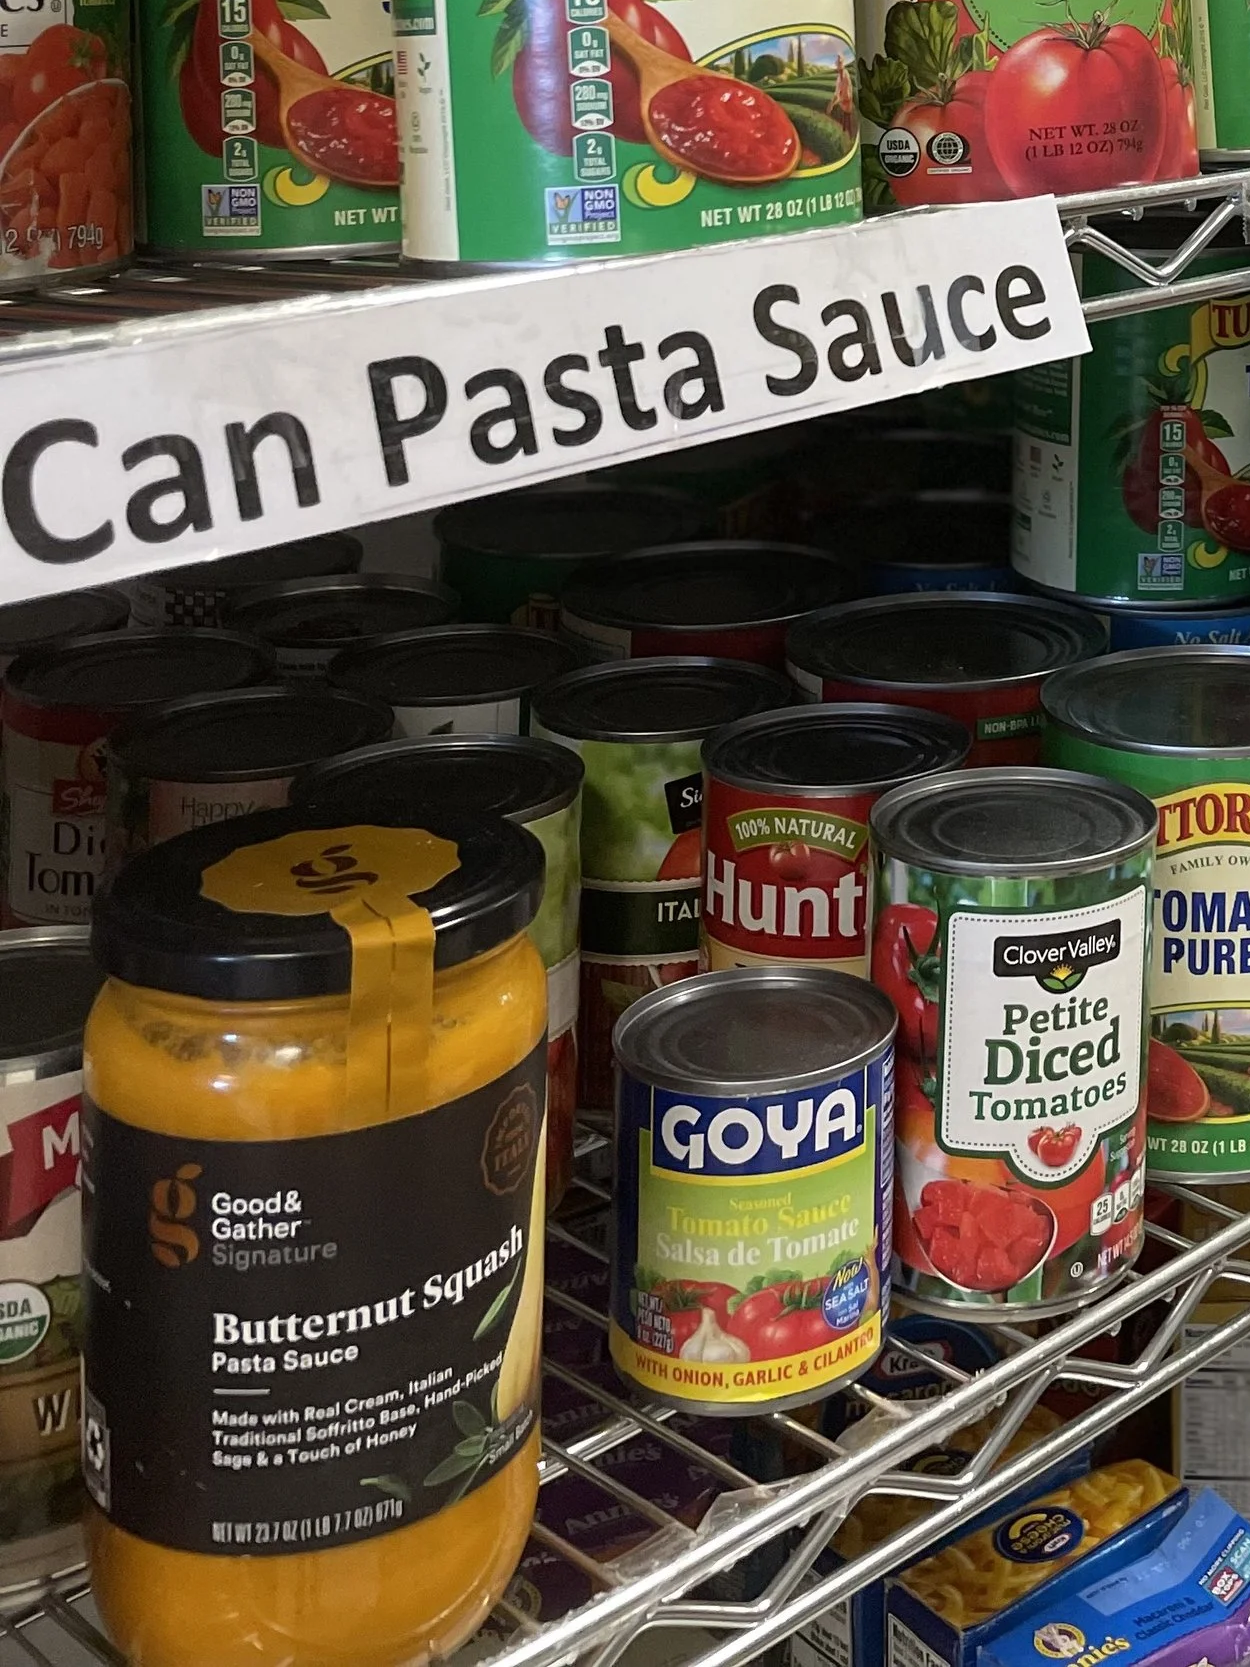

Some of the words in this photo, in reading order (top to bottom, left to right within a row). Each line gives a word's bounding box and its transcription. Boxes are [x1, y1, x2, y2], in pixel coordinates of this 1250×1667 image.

[887, 138, 911, 152] USDA
[584, 189, 615, 201] NON
[701, 207, 732, 227] NET
[738, 204, 762, 224] WT
[766, 202, 783, 221] 28
[787, 198, 803, 218] OZ
[806, 196, 816, 218] (1
[820, 193, 832, 212] LB
[206, 216, 258, 226] VERIFIED
[334, 209, 366, 226] NET
[372, 207, 398, 223] WT
[549, 221, 617, 235] VERIFIED
[2, 411, 321, 565] Can
[367, 325, 726, 487] Pasta
[753, 264, 1052, 397] Sauce
[735, 817, 770, 841] 100%
[774, 816, 857, 850] NATURAL
[1170, 854, 1224, 876] FAMILY
[1003, 944, 1066, 965] Clover
[1068, 934, 1113, 959] Valley
[1003, 996, 1109, 1036] Petite
[984, 1015, 1121, 1085] Diced
[969, 1071, 1126, 1121] Tomatoes
[661, 1087, 857, 1170] GOYA
[667, 1206, 768, 1238] Tomato
[777, 1193, 851, 1231] Sauce
[729, 1192, 792, 1211] Seasoned
[1097, 1198, 1108, 1217] 25
[211, 1218, 302, 1242] Gather
[656, 1232, 720, 1266] Salsa
[728, 1241, 761, 1267] de
[767, 1218, 860, 1264] Tomate
[211, 1239, 338, 1271] Signature
[212, 1287, 416, 1346] Butternut
[422, 1224, 523, 1311] Squash
[824, 1293, 847, 1311] SEA
[848, 1277, 869, 1300] SALT
[211, 1349, 276, 1375] Pasta
[283, 1343, 359, 1372] Sauce
[635, 1352, 668, 1378] WITH
[673, 1367, 730, 1389] ONION,
[733, 1361, 793, 1386] GARLIC
[798, 1359, 809, 1376] &
[813, 1327, 874, 1372] CILANTRO
[211, 1409, 259, 1428] Made
[261, 1406, 300, 1426] with
[304, 1400, 341, 1423] Real
[344, 1388, 405, 1415] Cream,
[408, 1366, 454, 1396] Italian
[211, 1428, 301, 1448] Traditional
[306, 1413, 376, 1442] Soffritto
[379, 1401, 421, 1426] Base,
[424, 1350, 503, 1410] Hand-Picked
[1211, 1570, 1231, 1596] BOX
